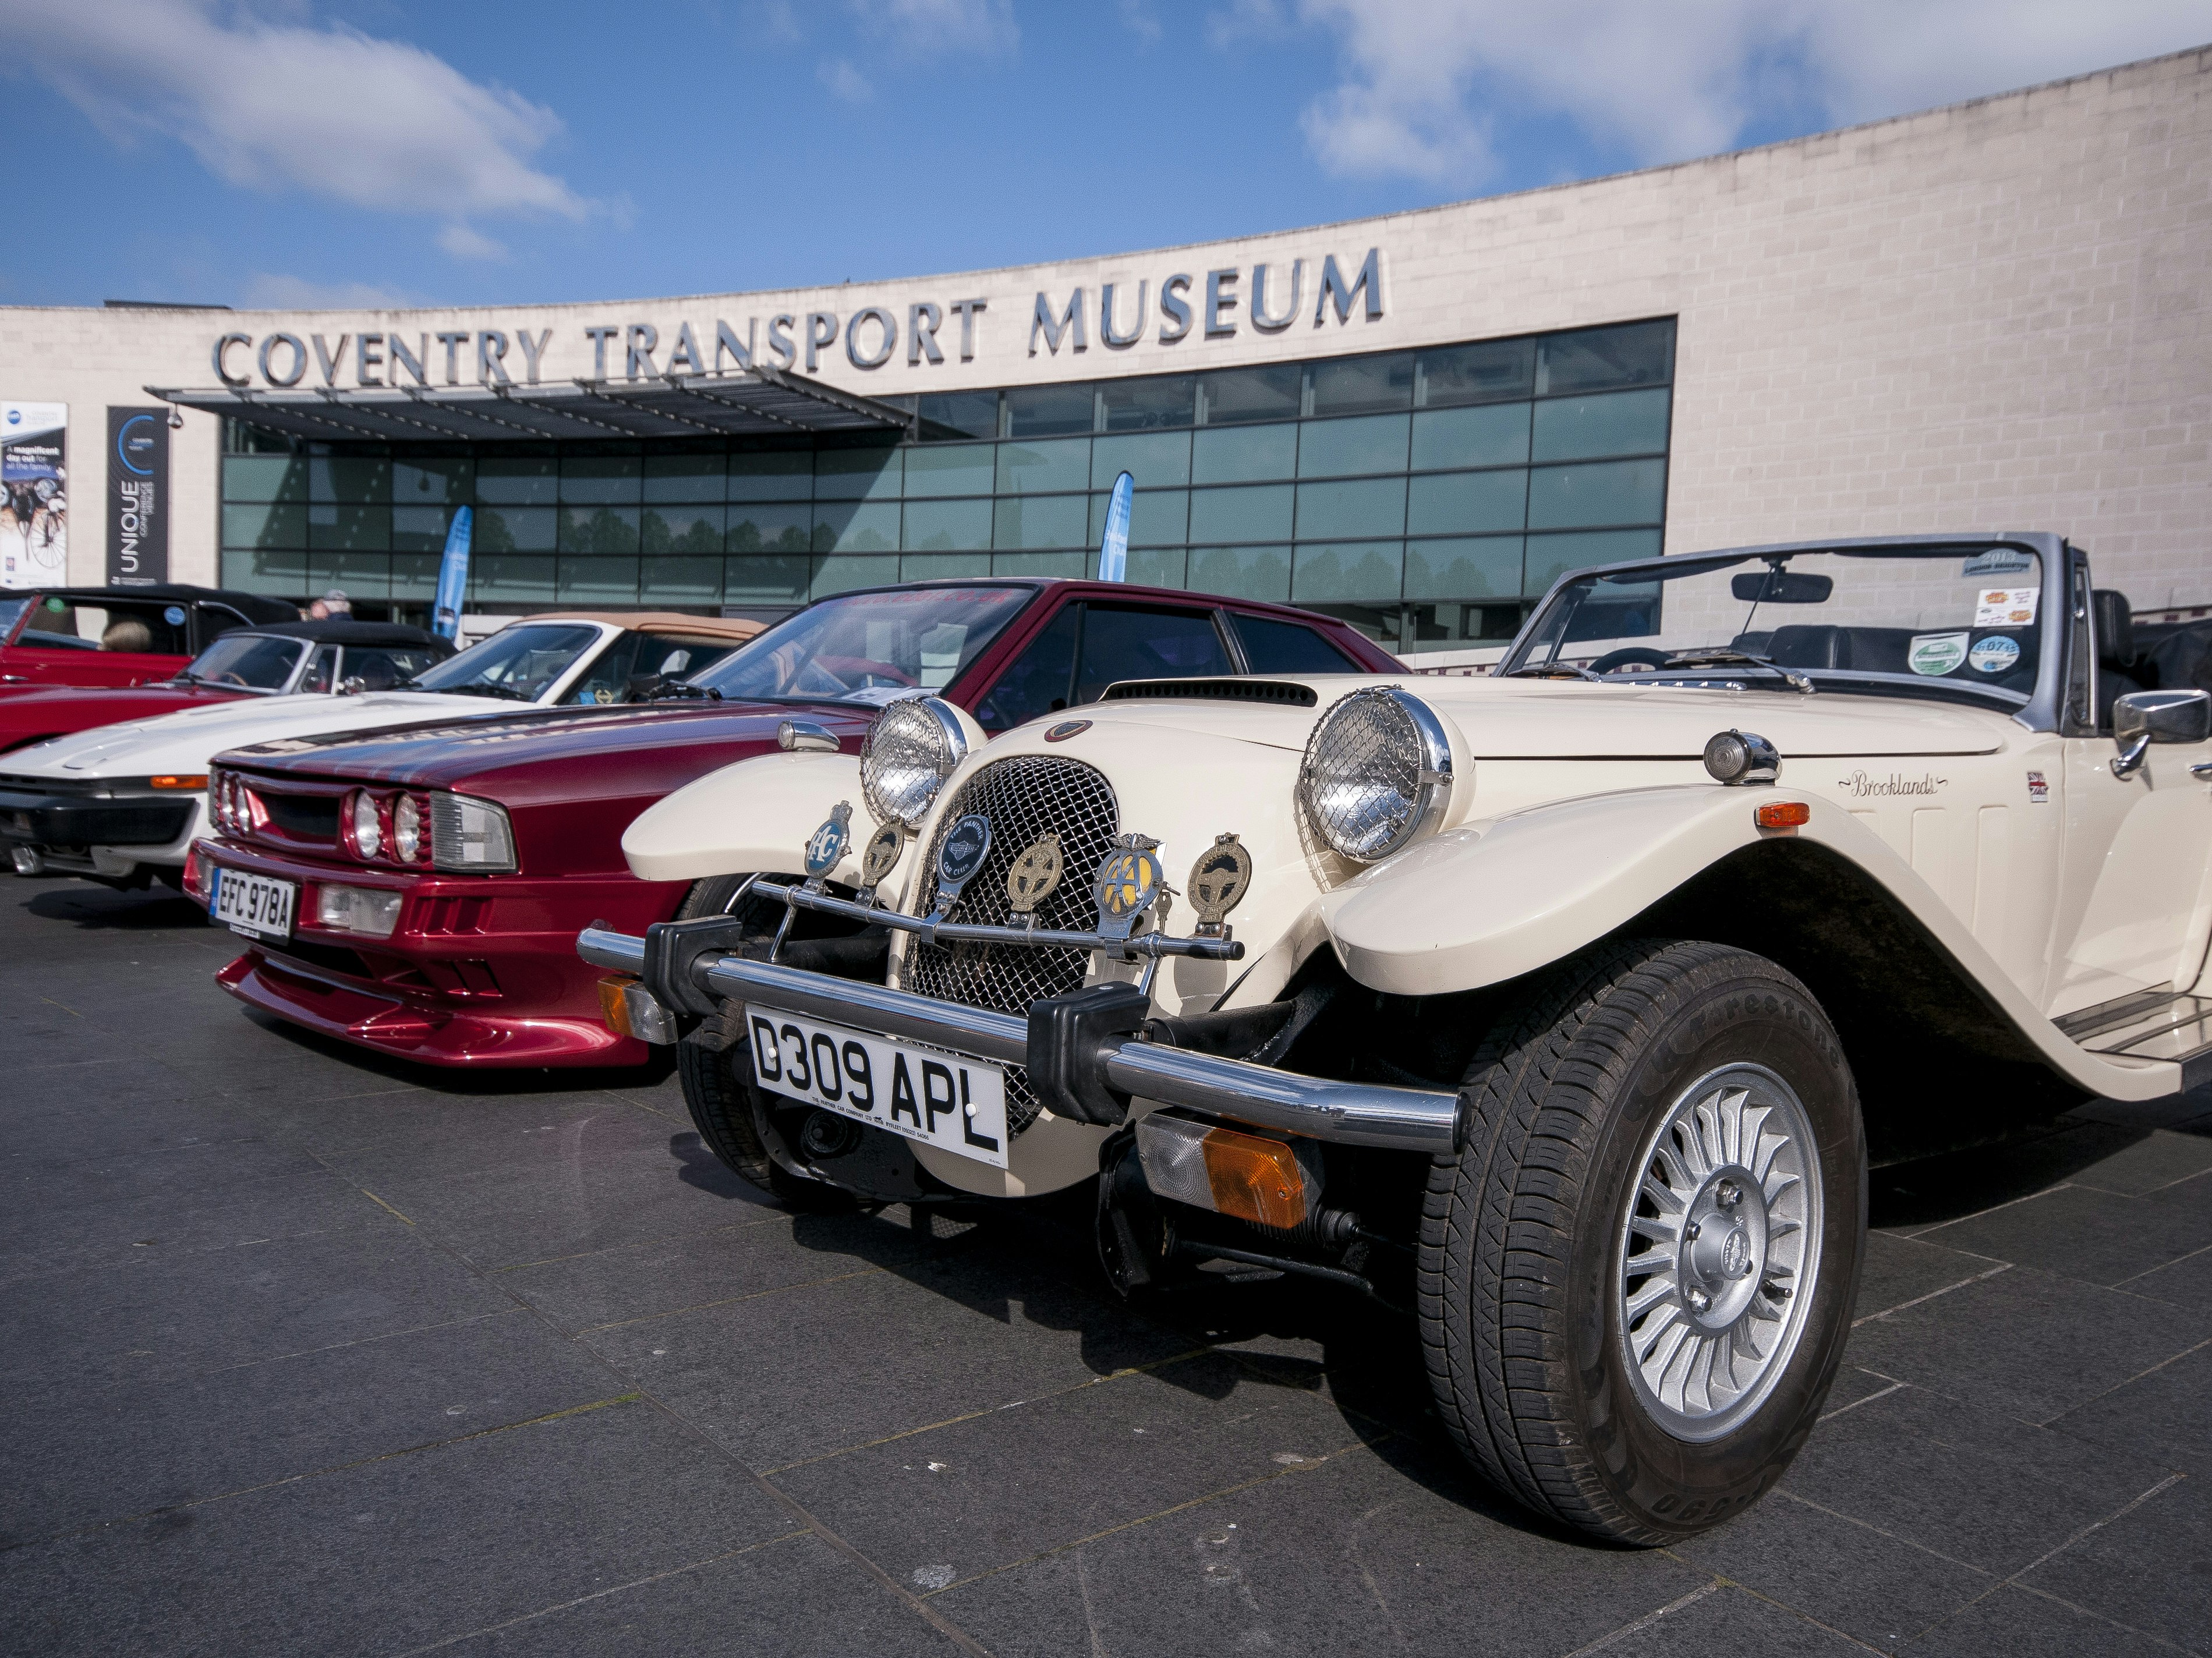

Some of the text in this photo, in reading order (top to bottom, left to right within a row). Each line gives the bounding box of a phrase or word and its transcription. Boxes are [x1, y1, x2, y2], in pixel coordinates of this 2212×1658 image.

[211, 247, 1384, 388] COVENTRY TRANSPORT MUSEUM
[6, 455, 20, 463] day
[22, 454, 35, 462] out
[14, 446, 59, 456] magnificent
[140, 481, 148, 537] CONFERENCE
[146, 481, 154, 515] VENUES
[121, 481, 140, 572] UNIQUE
[1851, 769, 1938, 797] Brooklands
[808, 825, 838, 863] RAC
[950, 820, 983, 841] THE PANTHER
[943, 862, 970, 876] CAR CLUB
[220, 875, 288, 929] EFC 978A
[1689, 993, 1841, 1069] Firestone
[751, 1015, 999, 1153] D309 APL
[820, 1099, 836, 1109] PANTHER
[846, 1108, 863, 1119] COMPANY
[886, 1121, 901, 1131] BYFLEET
